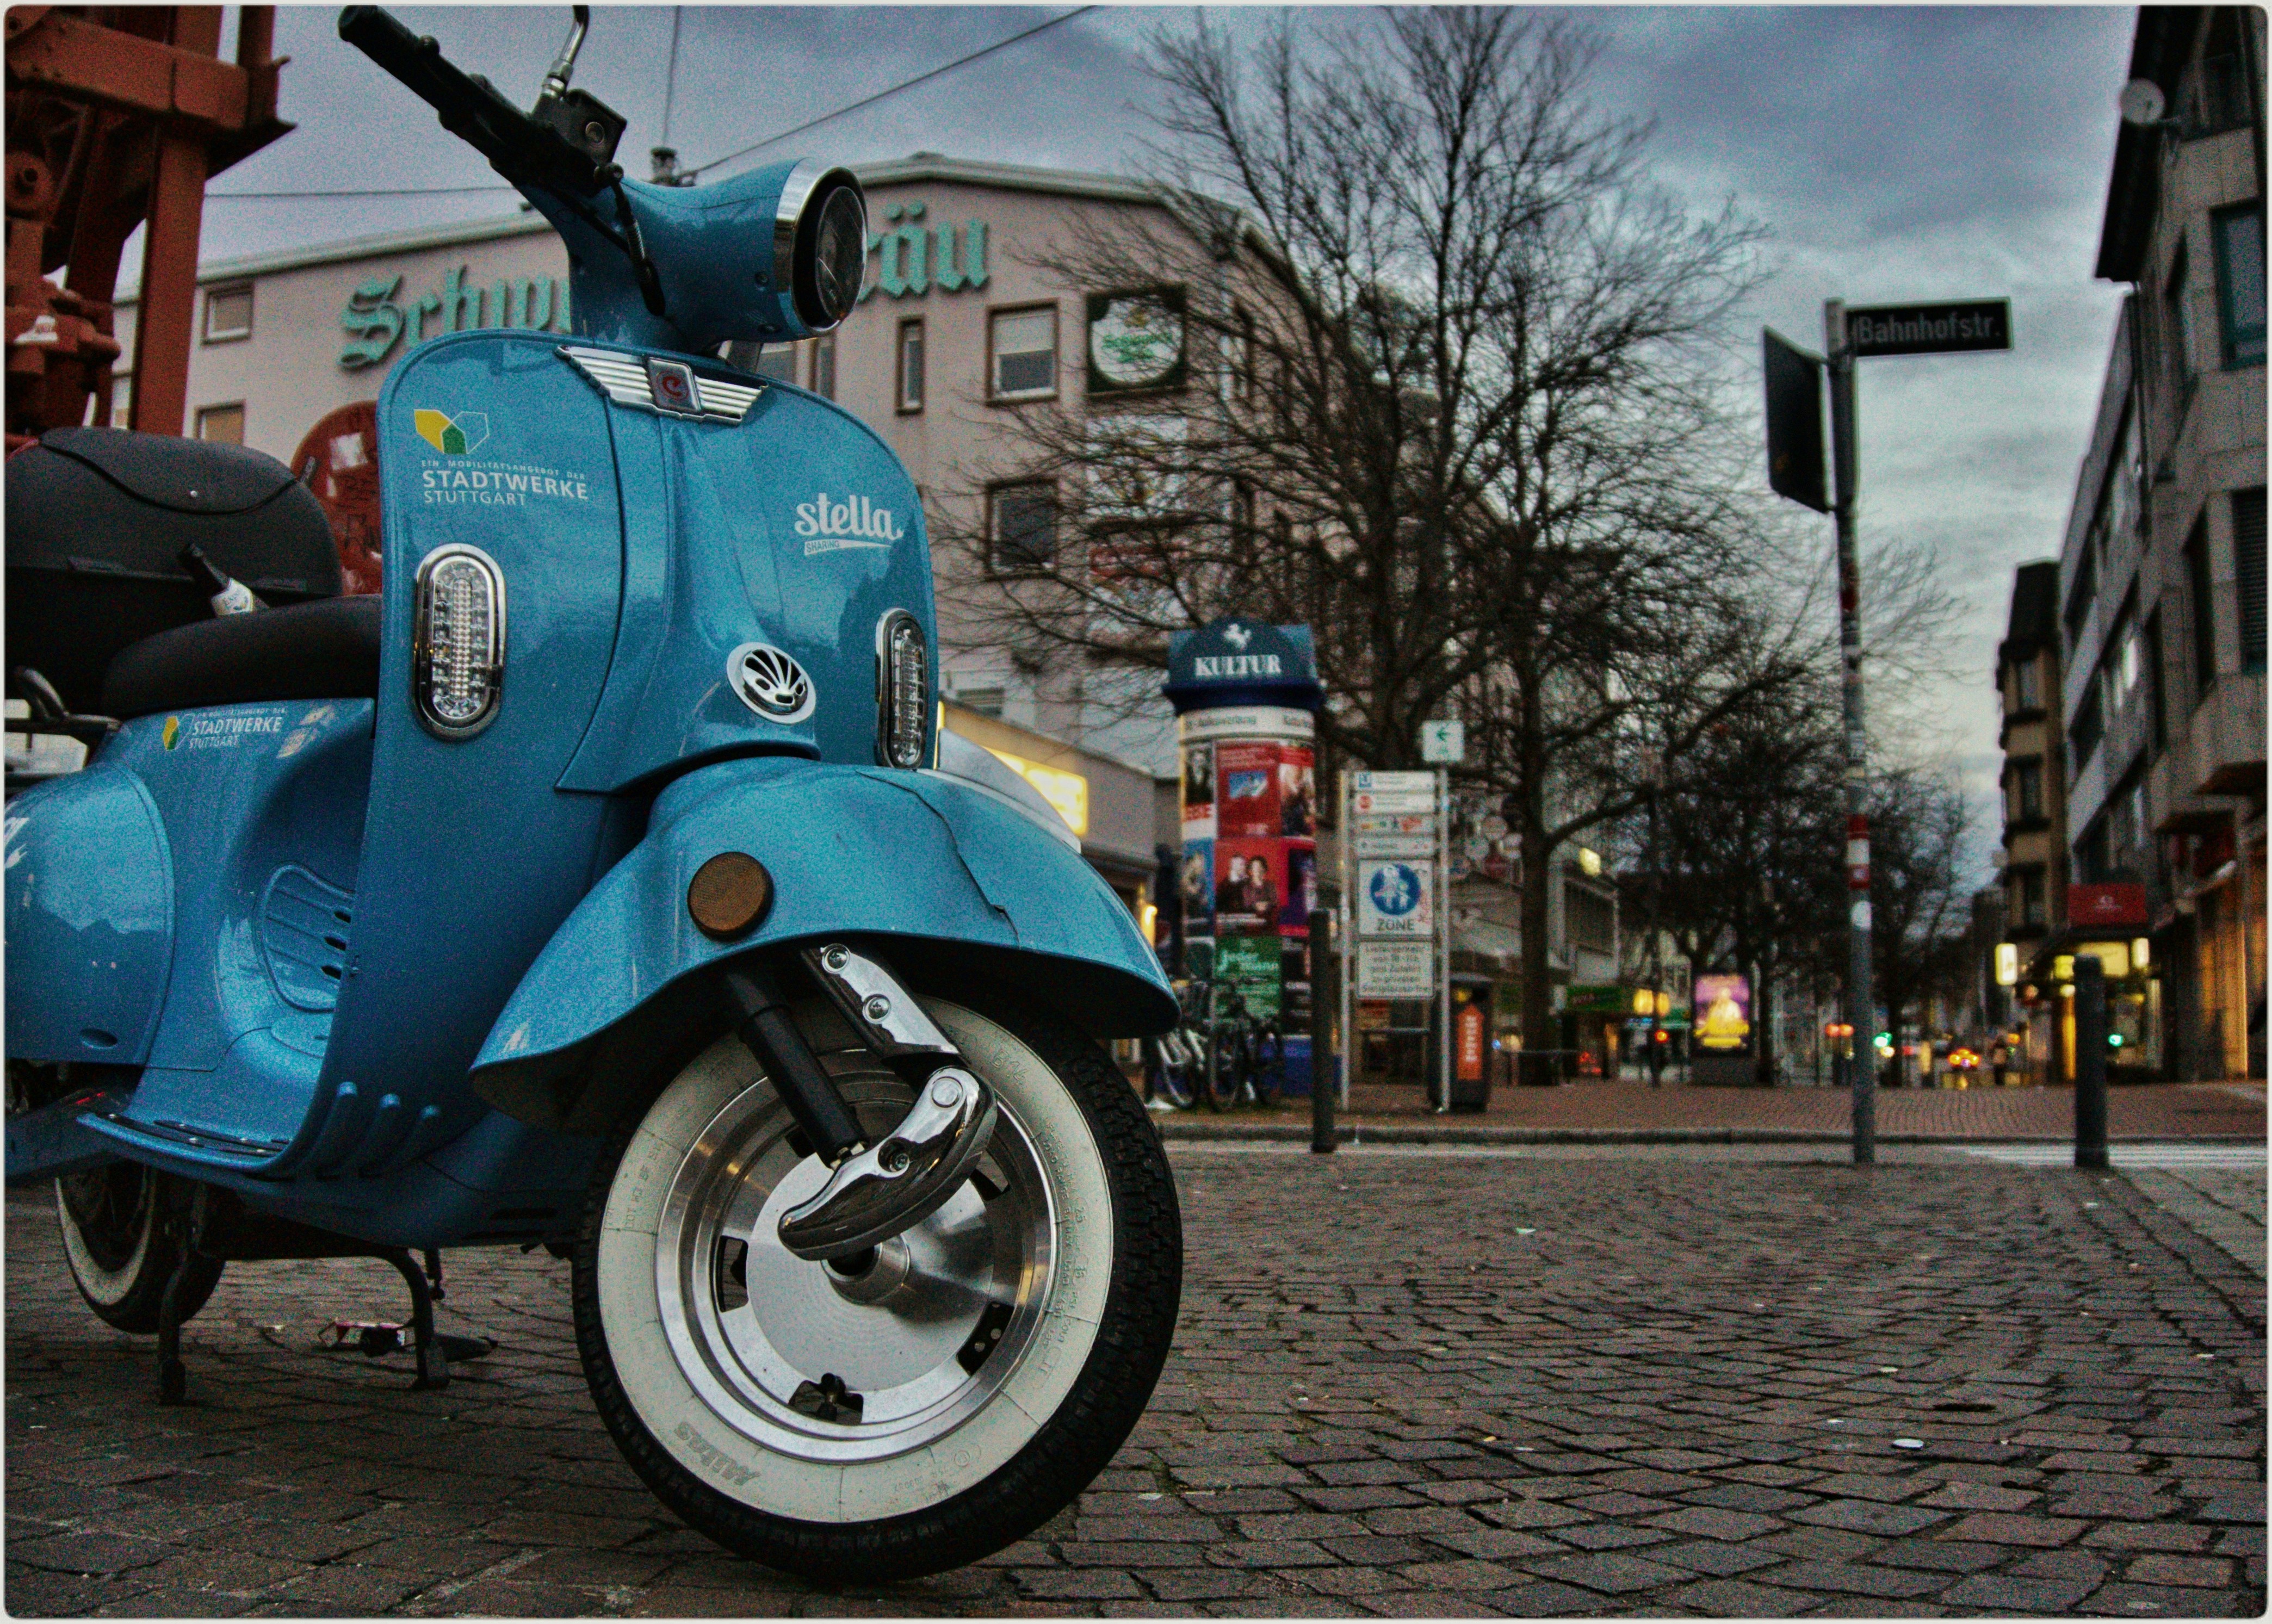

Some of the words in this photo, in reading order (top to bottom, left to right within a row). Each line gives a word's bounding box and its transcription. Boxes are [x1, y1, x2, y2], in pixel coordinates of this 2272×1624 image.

[1855, 311, 2001, 343] Bahnhofstr.
[567, 471, 585, 480] DER
[423, 470, 588, 500] STADTWERKE
[424, 491, 526, 506] STUTTGART
[794, 492, 904, 540] stella
[806, 540, 840, 554] SHARING
[1196, 654, 1281, 677] KULTUR
[192, 716, 282, 735] STADTWERKE
[189, 735, 239, 749] STUTTGART
[1377, 918, 1415, 931] ZONE
